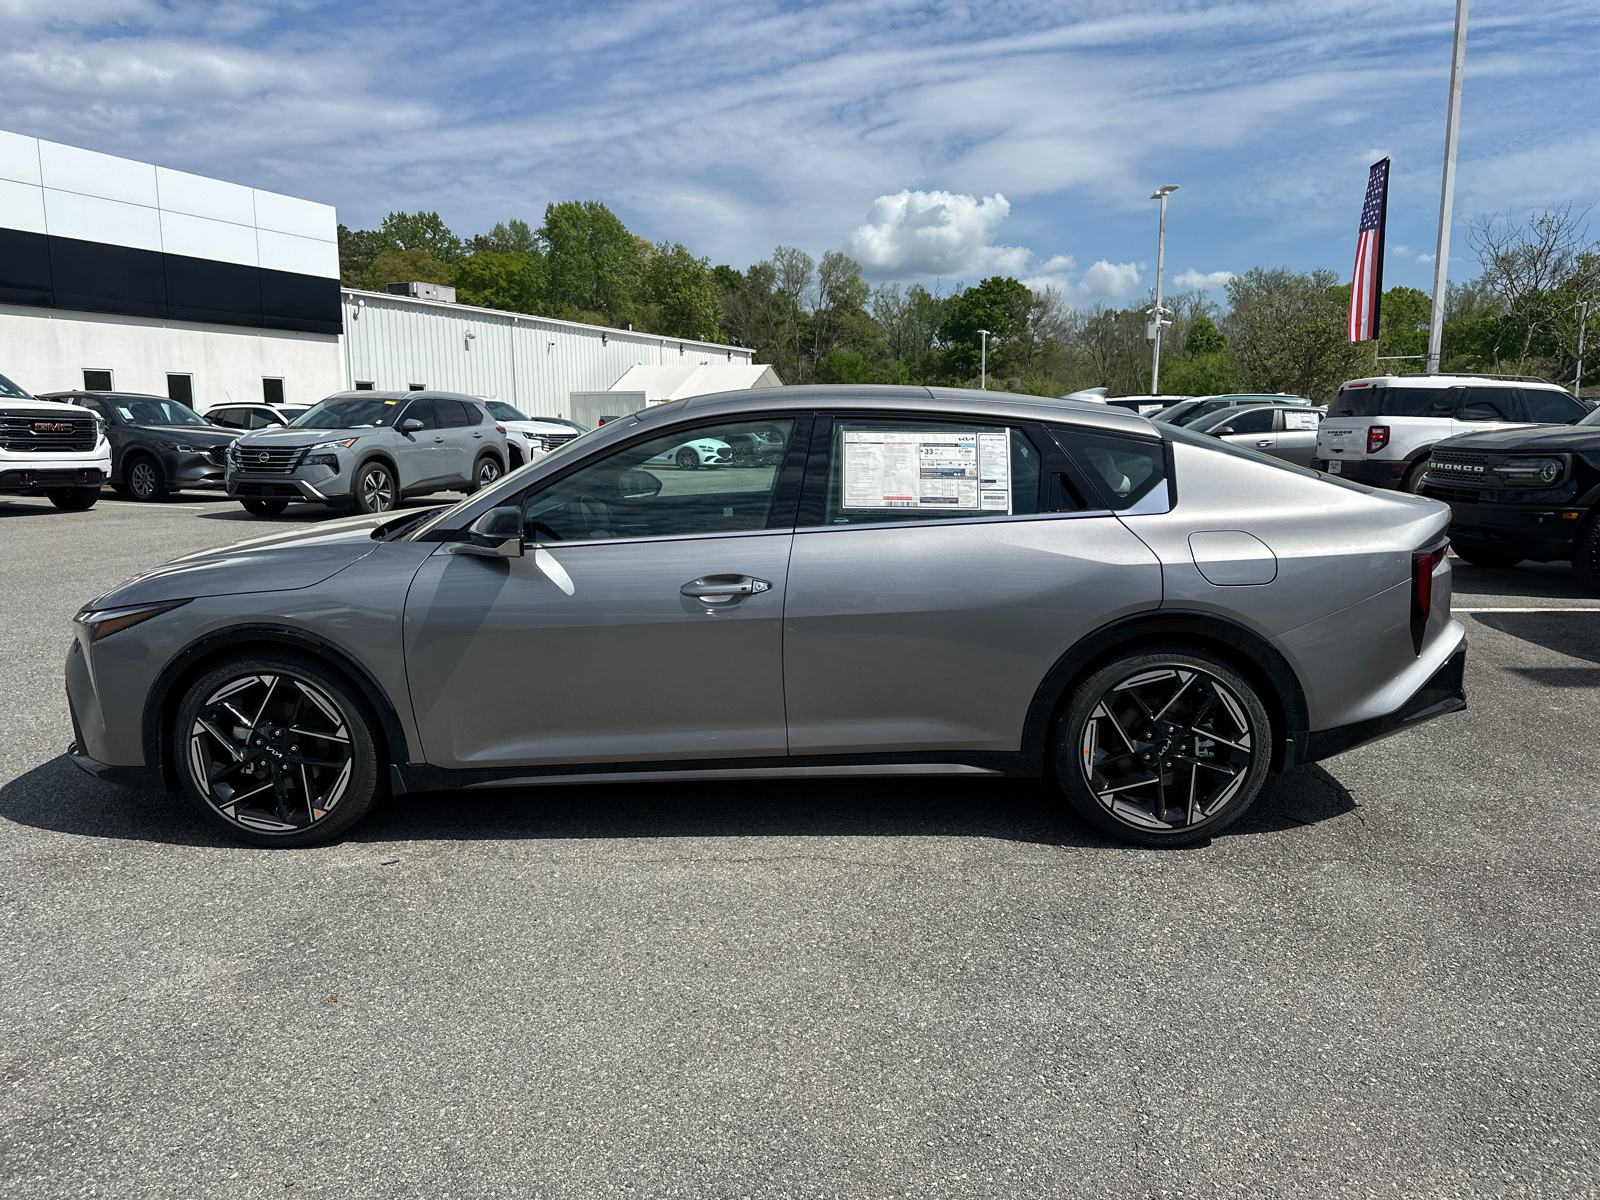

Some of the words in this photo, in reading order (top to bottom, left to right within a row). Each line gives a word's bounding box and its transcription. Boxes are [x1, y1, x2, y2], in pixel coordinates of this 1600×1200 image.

[35, 423, 73, 431] GMC
[1430, 462, 1484, 472] BRONCO
[1142, 654, 1196, 664] KUMHO
